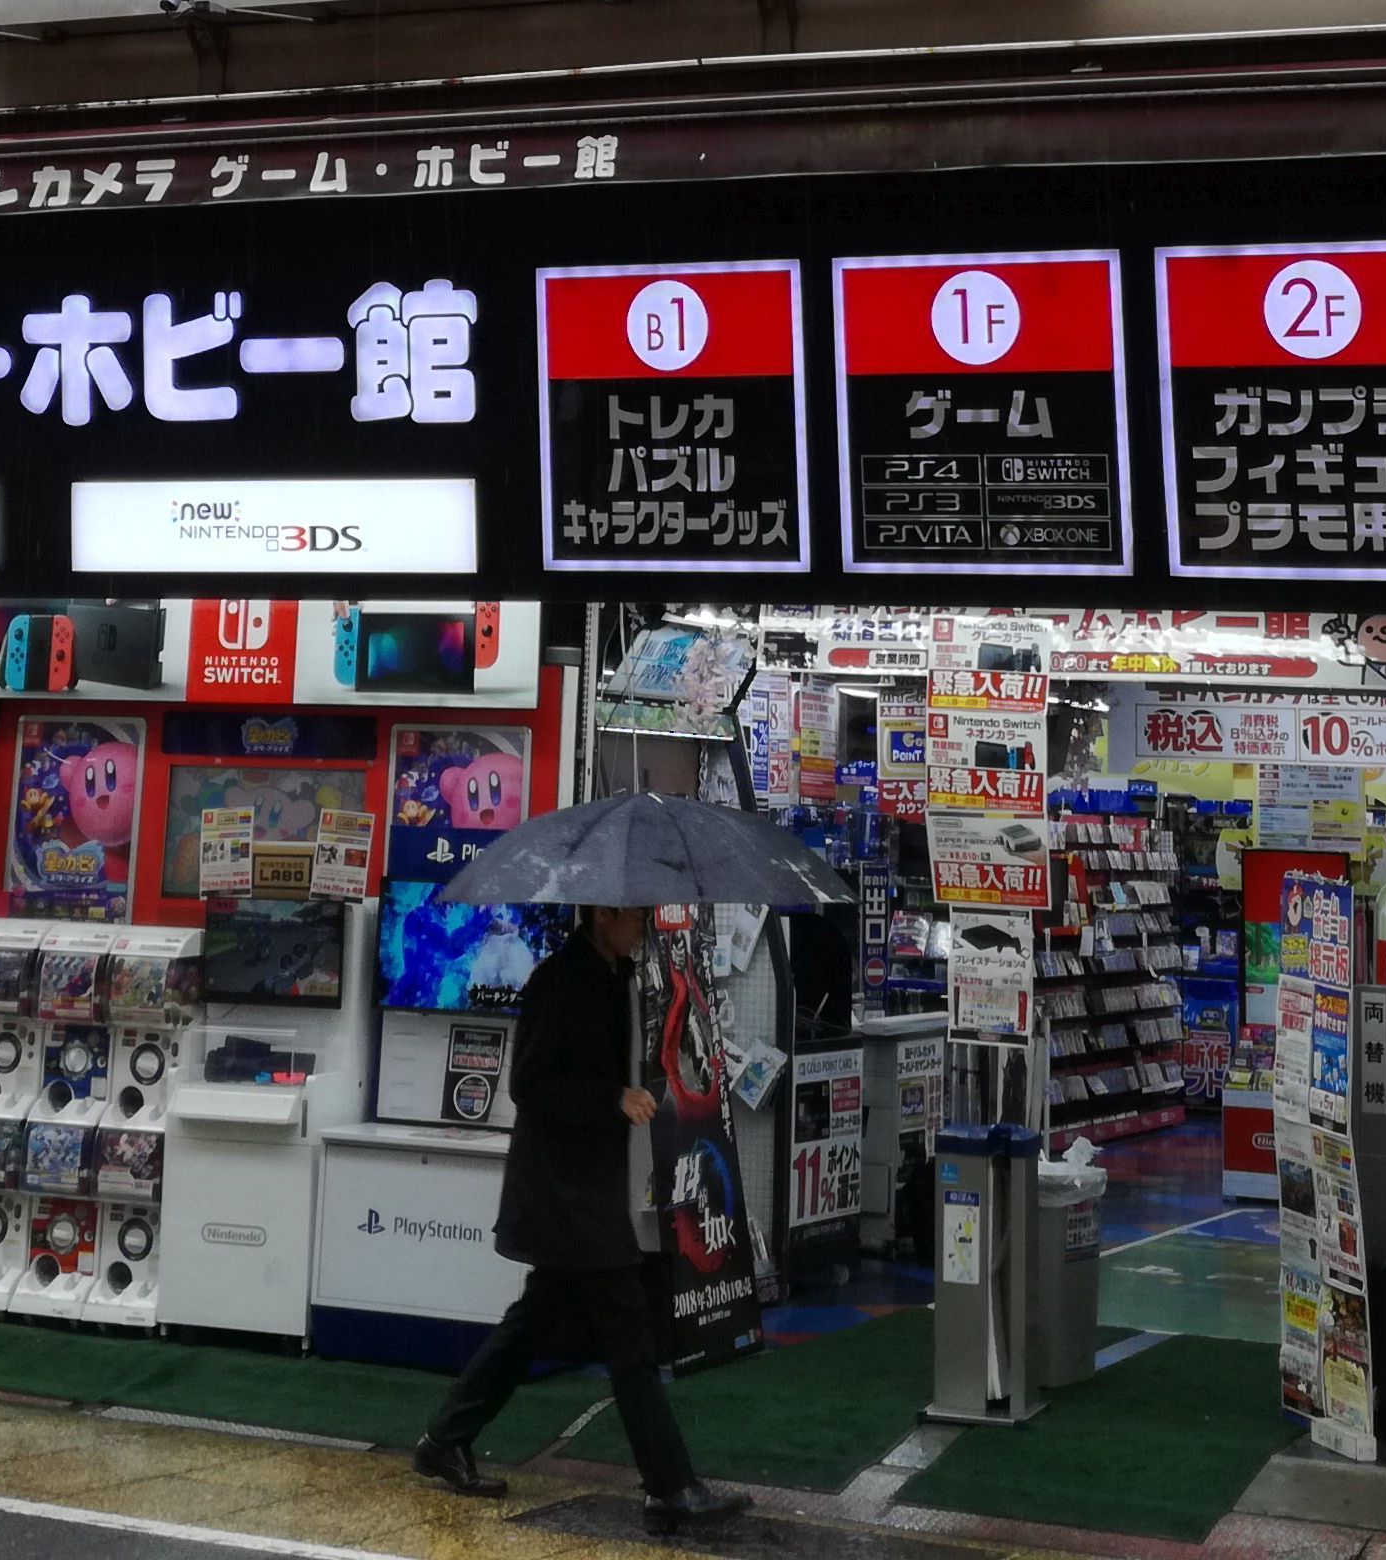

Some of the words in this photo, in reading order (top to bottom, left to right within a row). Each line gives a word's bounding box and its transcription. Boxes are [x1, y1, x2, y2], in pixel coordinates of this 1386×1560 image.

[210, 135, 623, 200] ゲーム・ホビー館
[952, 289, 1007, 344] 1F
[1282, 278, 1345, 338] 2F
[646, 298, 686, 352] B1
[607, 395, 734, 440] トレカ
[905, 391, 1052, 440] ゲーム
[607, 448, 736, 493] パズル
[885, 460, 960, 479] PS4
[1026, 467, 1090, 480] SWITCH
[180, 502, 233, 520] new
[886, 493, 960, 511] PS3
[1052, 495, 1095, 509] 3DS
[562, 500, 788, 546] キャラクターグッズ
[1023, 528, 1064, 542] XBOX
[1067, 528, 1099, 542] ONE
[180, 526, 267, 539] NINTENDO
[281, 525, 363, 552] 3DS
[204, 656, 277, 665] NINTENDO
[875, 652, 921, 666] 営業時間
[203, 667, 277, 684] SWITCH
[931, 671, 1044, 700] 緊急入荷!!
[953, 715, 1000, 728] Nintendo
[1003, 717, 1041, 731] Switch
[965, 728, 1027, 740] ネオンカラー
[1146, 714, 1223, 755] 税込
[1240, 715, 1278, 727] 消費税
[1233, 742, 1286, 756] 特価表示
[929, 768, 1040, 798] 緊急入荷!!
[259, 871, 304, 882] LABO
[260, 861, 305, 870] NINTENDO
[938, 862, 1042, 892] 緊急入荷!!
[865, 888, 885, 944] 出口
[1362, 999, 1386, 1107] 両替機
[827, 1143, 860, 1175] ポイント
[206, 1226, 262, 1243] Nintendo
[394, 1216, 484, 1243] PlayStation
[700, 1213, 736, 1256] 如く
